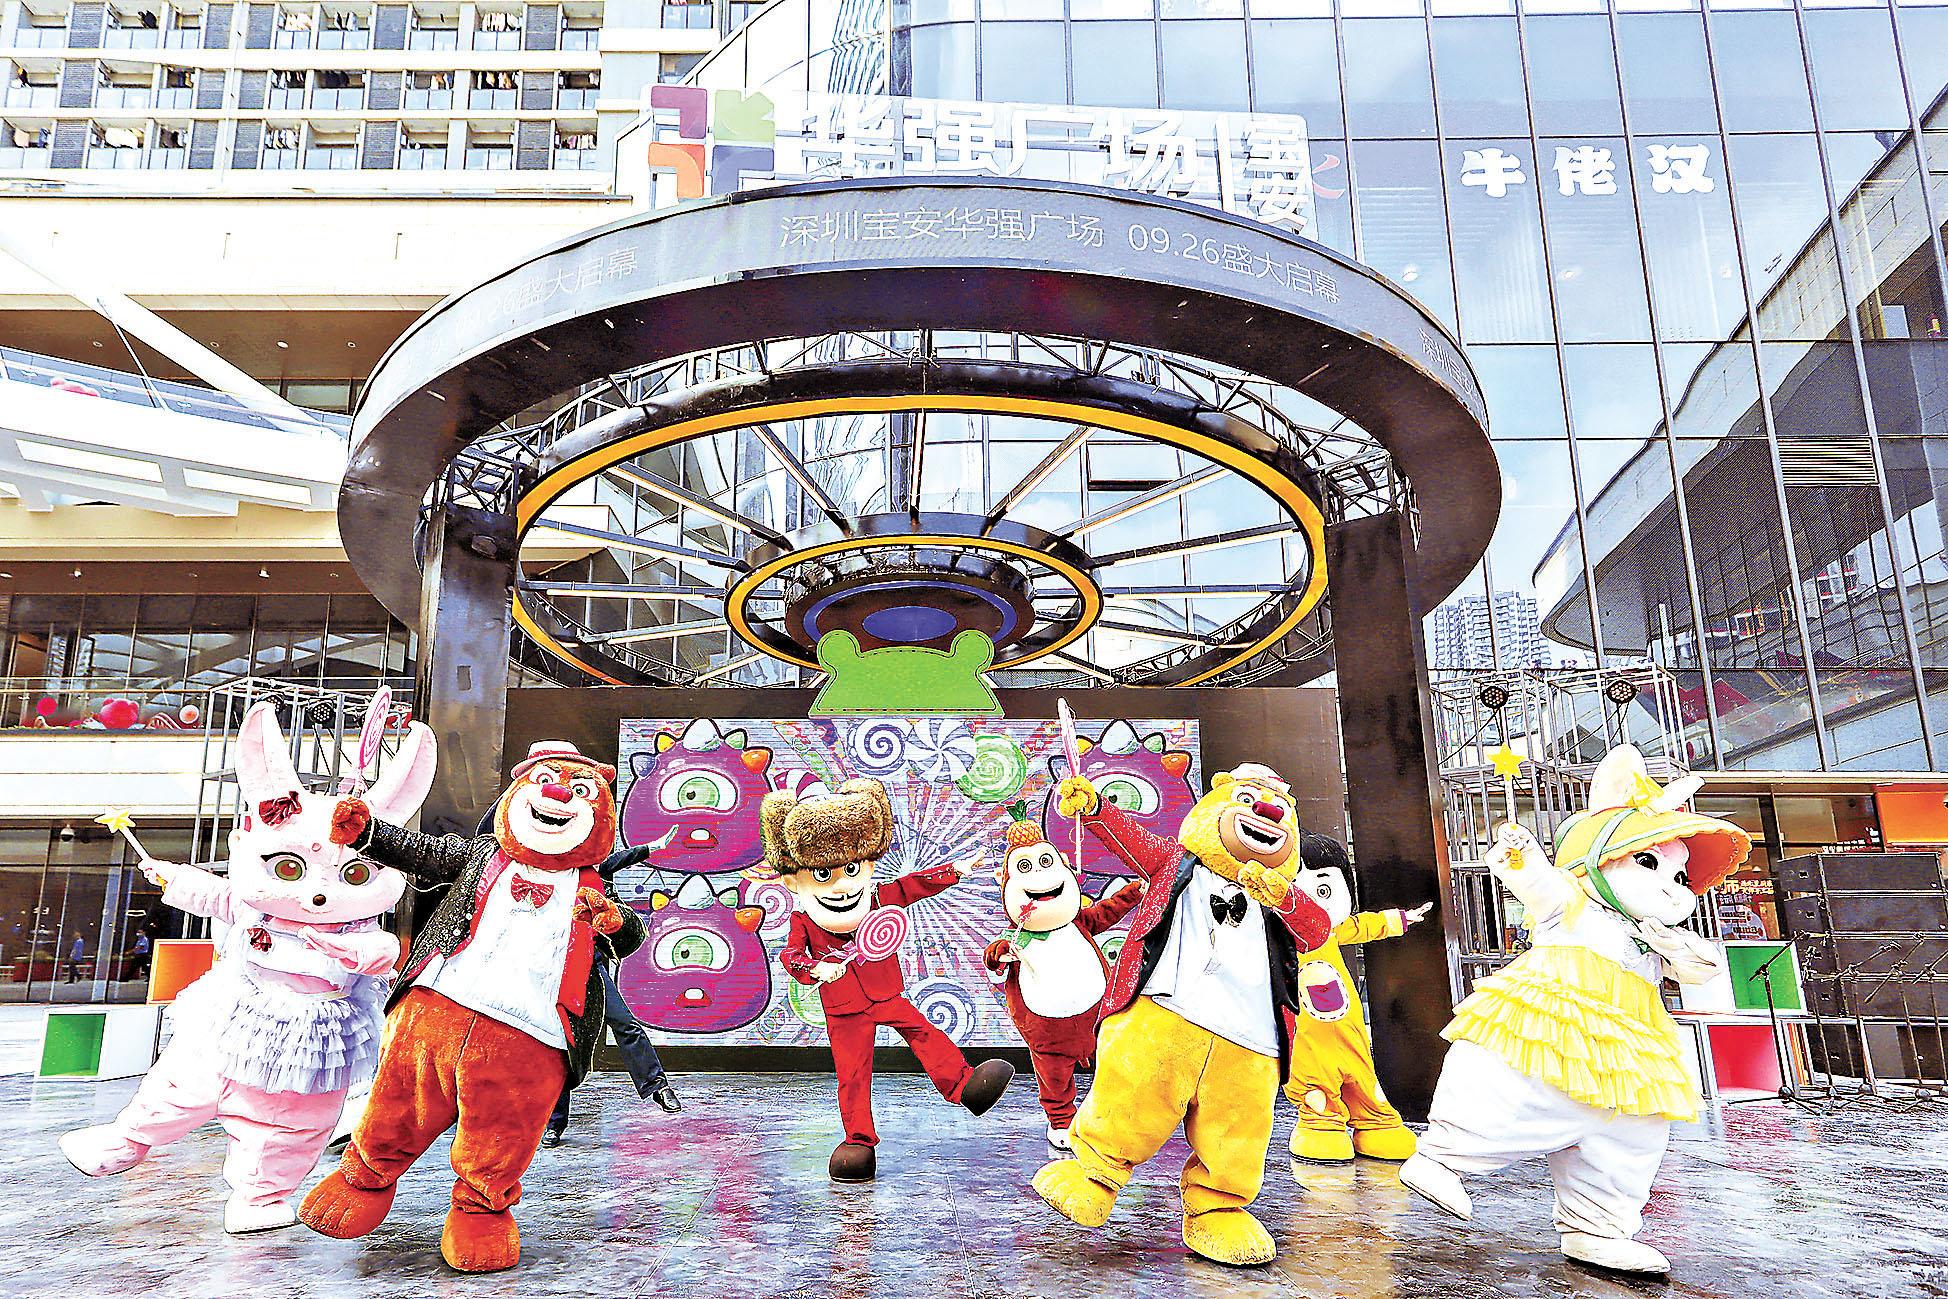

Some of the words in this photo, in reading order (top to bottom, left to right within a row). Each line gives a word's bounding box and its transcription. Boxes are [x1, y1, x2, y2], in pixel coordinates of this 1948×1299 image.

[800, 97, 1198, 197] 华强广场
[1245, 117, 1309, 233] 宝安
[1461, 143, 1715, 198] 牛佬汉
[780, 206, 1104, 248] 深圳宝安华强广场
[1128, 224, 1341, 304] 09.26盛大启幕
